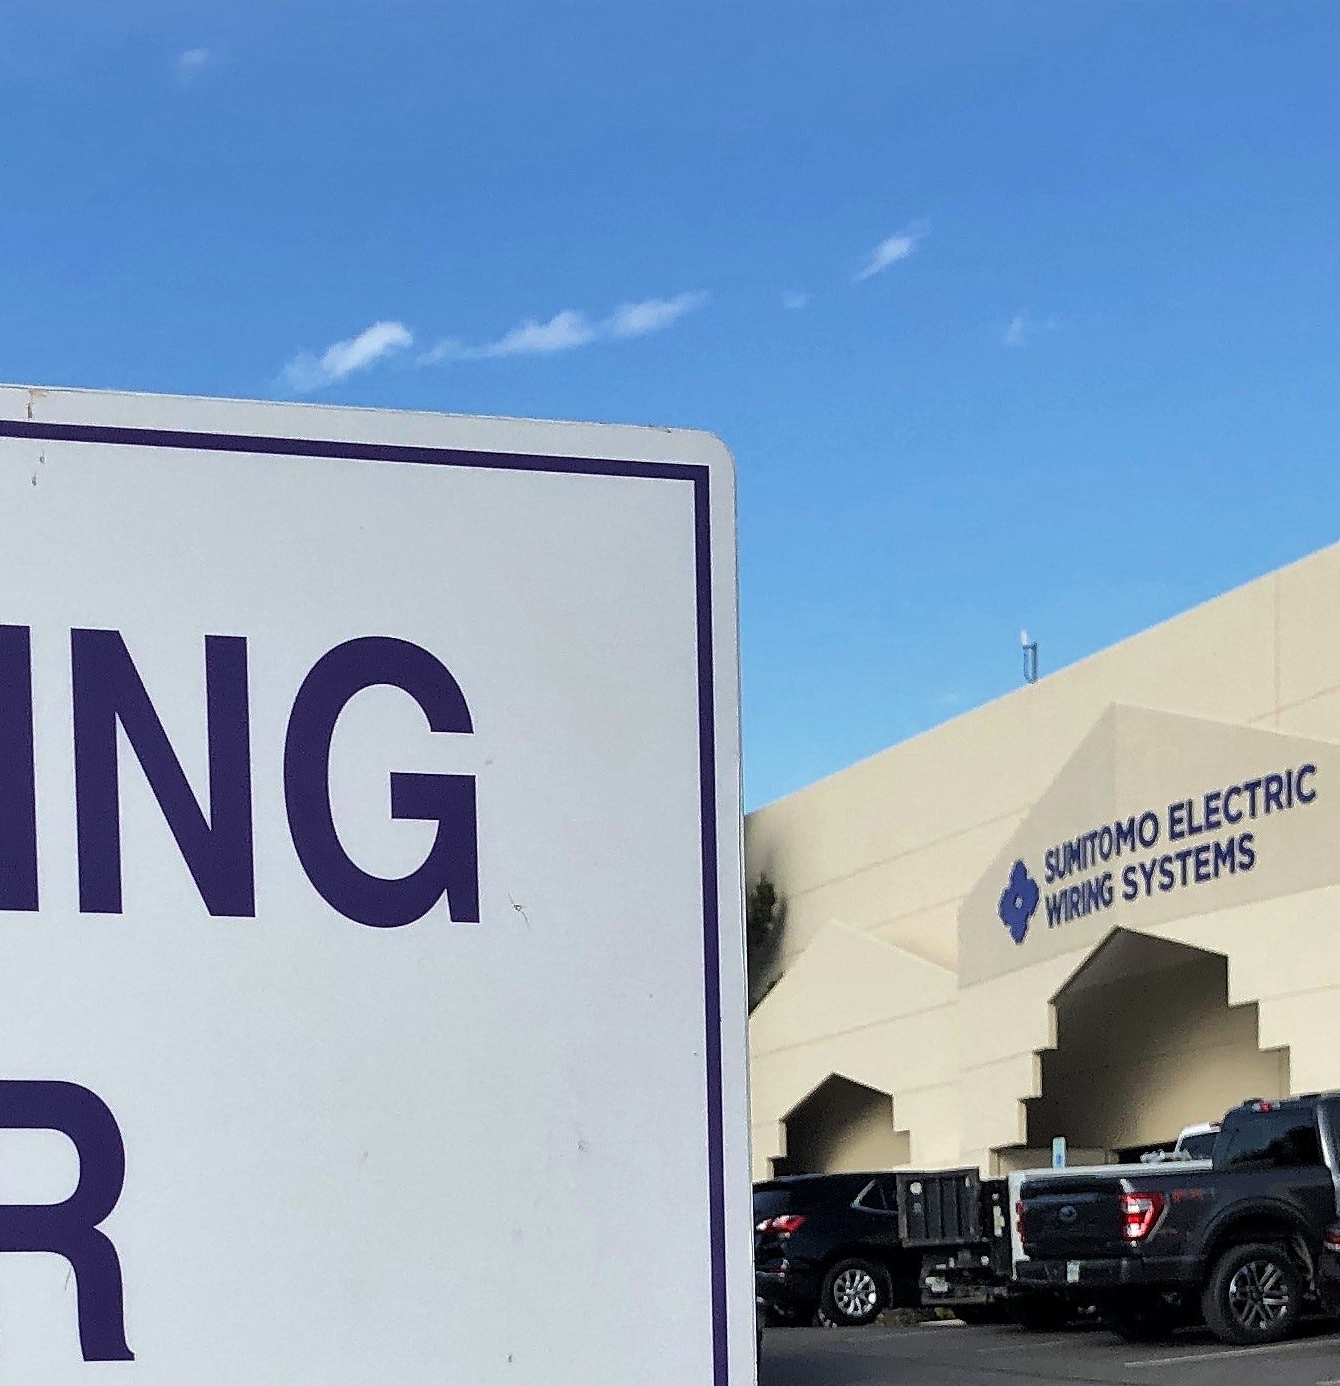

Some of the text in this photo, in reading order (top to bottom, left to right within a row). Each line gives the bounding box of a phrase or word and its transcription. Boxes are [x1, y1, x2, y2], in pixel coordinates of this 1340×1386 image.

[1044, 763, 1316, 884] SUMITOMO ELECTRIC
[1045, 832, 1255, 929] WIRING SYSTEMS
